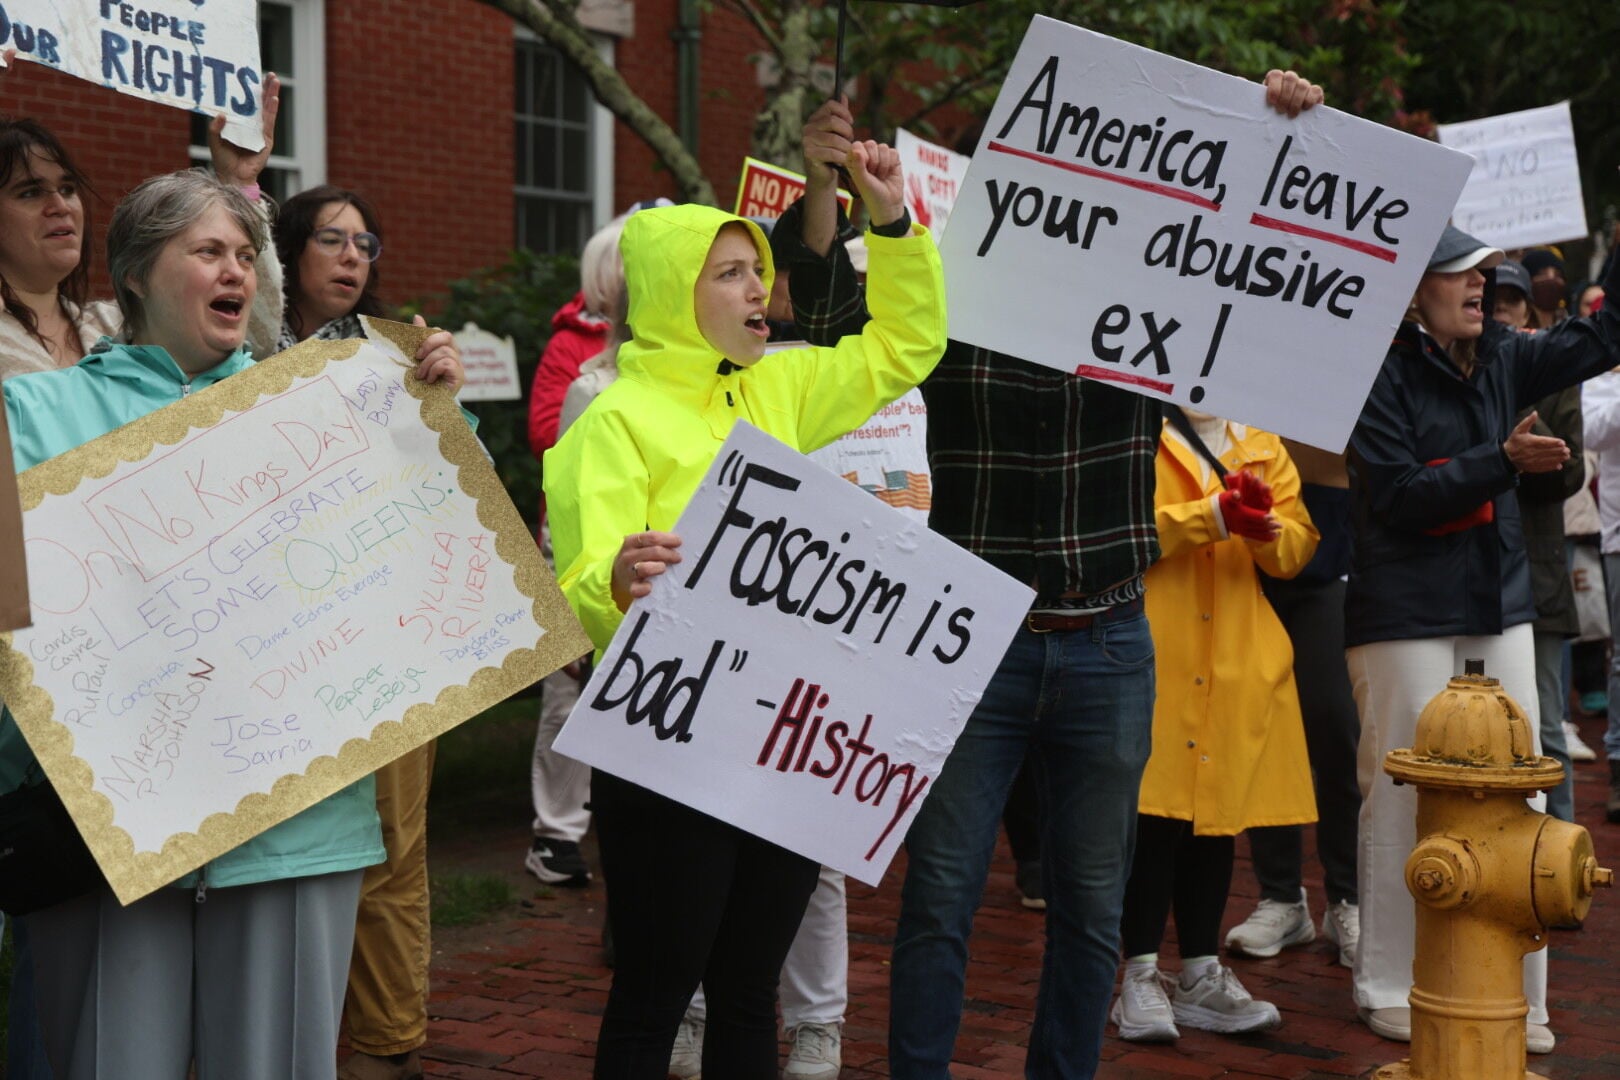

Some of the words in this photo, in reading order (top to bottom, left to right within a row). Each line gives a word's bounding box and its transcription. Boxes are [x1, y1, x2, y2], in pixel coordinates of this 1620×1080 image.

[101, 28, 260, 117] RIGHTS
[749, 172, 780, 206] NO
[996, 55, 1227, 203] America,
[1260, 135, 1409, 244] leave
[977, 179, 1118, 257] your
[1144, 215, 1365, 319] abusive
[340, 368, 382, 411] LADY
[367, 379, 406, 427] Bunny
[25, 537, 123, 615] On
[104, 488, 193, 566] No
[185, 459, 288, 519] Kings
[89, 567, 211, 652] LET'S
[208, 468, 377, 575] CELEBRATE
[685, 449, 907, 645] "Fascism
[905, 583, 975, 664] is
[163, 575, 278, 652] SOME
[236, 626, 291, 660] Dame
[292, 602, 335, 629] Edna
[335, 564, 393, 603] Everage
[399, 532, 459, 643] SYLVIA
[441, 534, 491, 638] RIVERA
[29, 625, 88, 662] Candis
[51, 637, 102, 672] Cayne
[250, 618, 364, 700] DIVINE
[64, 653, 111, 728] RuPaul
[154, 657, 215, 781] JOHNSON
[211, 713, 301, 747] Jose
[314, 663, 385, 719] Pepper
[101, 692, 180, 802] MARSHA
[222, 737, 313, 774] Sarria
